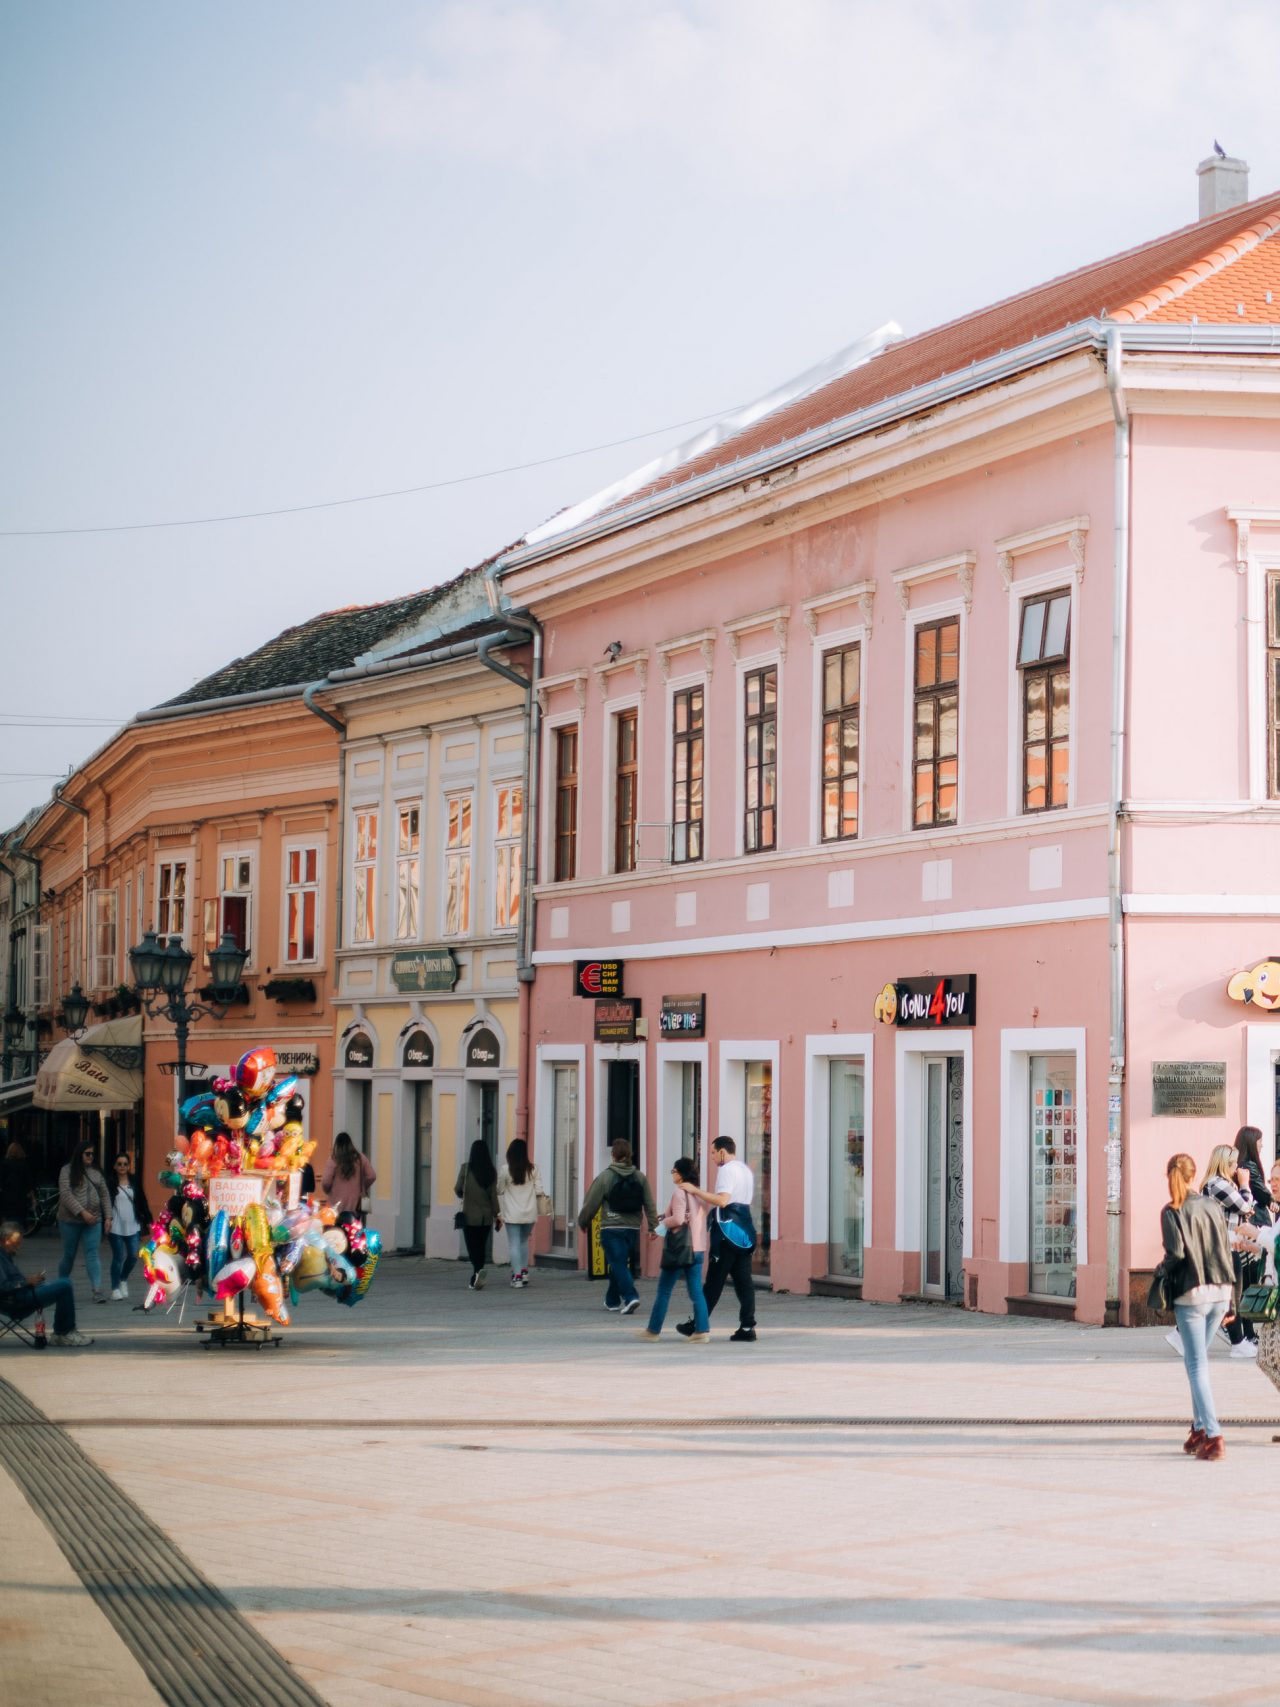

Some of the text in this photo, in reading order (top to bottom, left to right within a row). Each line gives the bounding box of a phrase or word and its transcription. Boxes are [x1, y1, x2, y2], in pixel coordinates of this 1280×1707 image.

[901, 993, 908, 1020] IS
[929, 979, 945, 1025] 4
[945, 992, 965, 1018] YOU
[66, 1083, 103, 1099] Zlatar
[215, 1181, 256, 1191] BALONI
